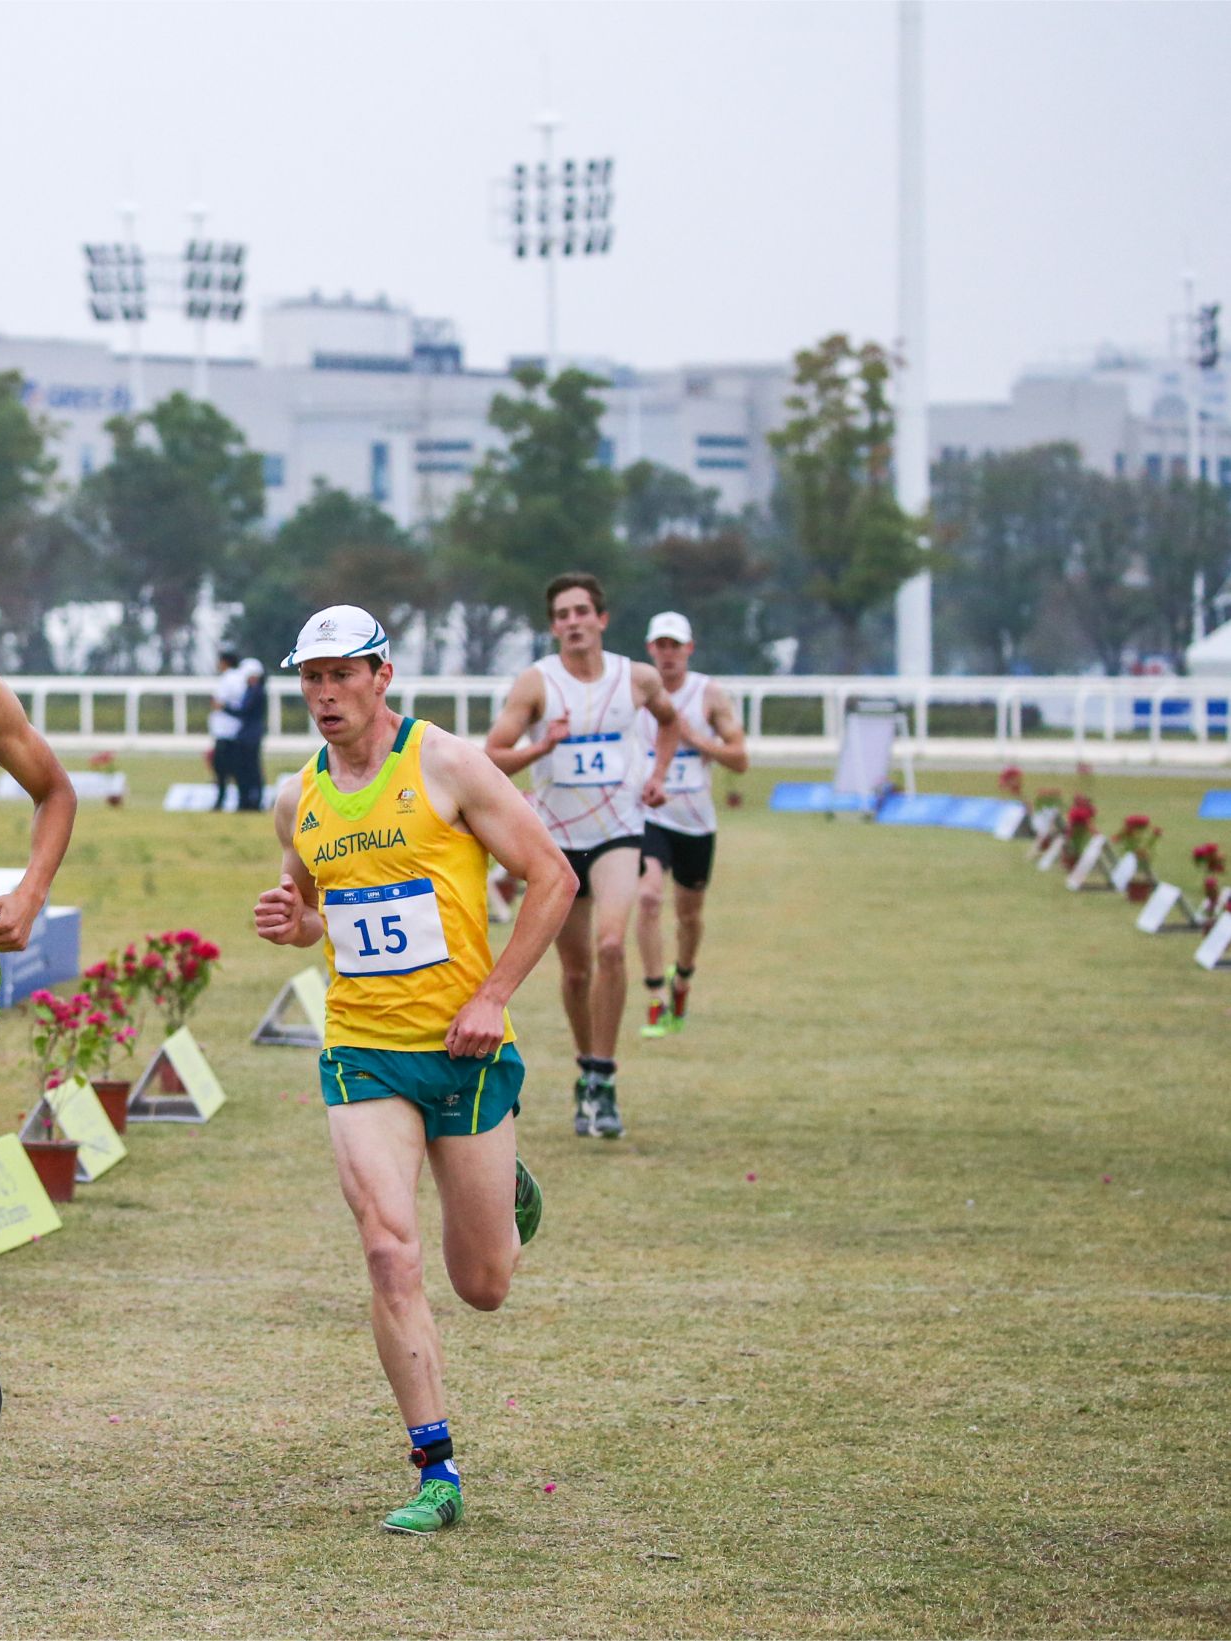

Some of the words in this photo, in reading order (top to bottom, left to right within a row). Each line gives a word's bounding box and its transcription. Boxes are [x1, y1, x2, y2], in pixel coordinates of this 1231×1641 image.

[573, 752, 606, 775] 14
[300, 821, 320, 833] adidas
[313, 827, 407, 866] AUSTRALIA
[354, 915, 408, 957] 15
